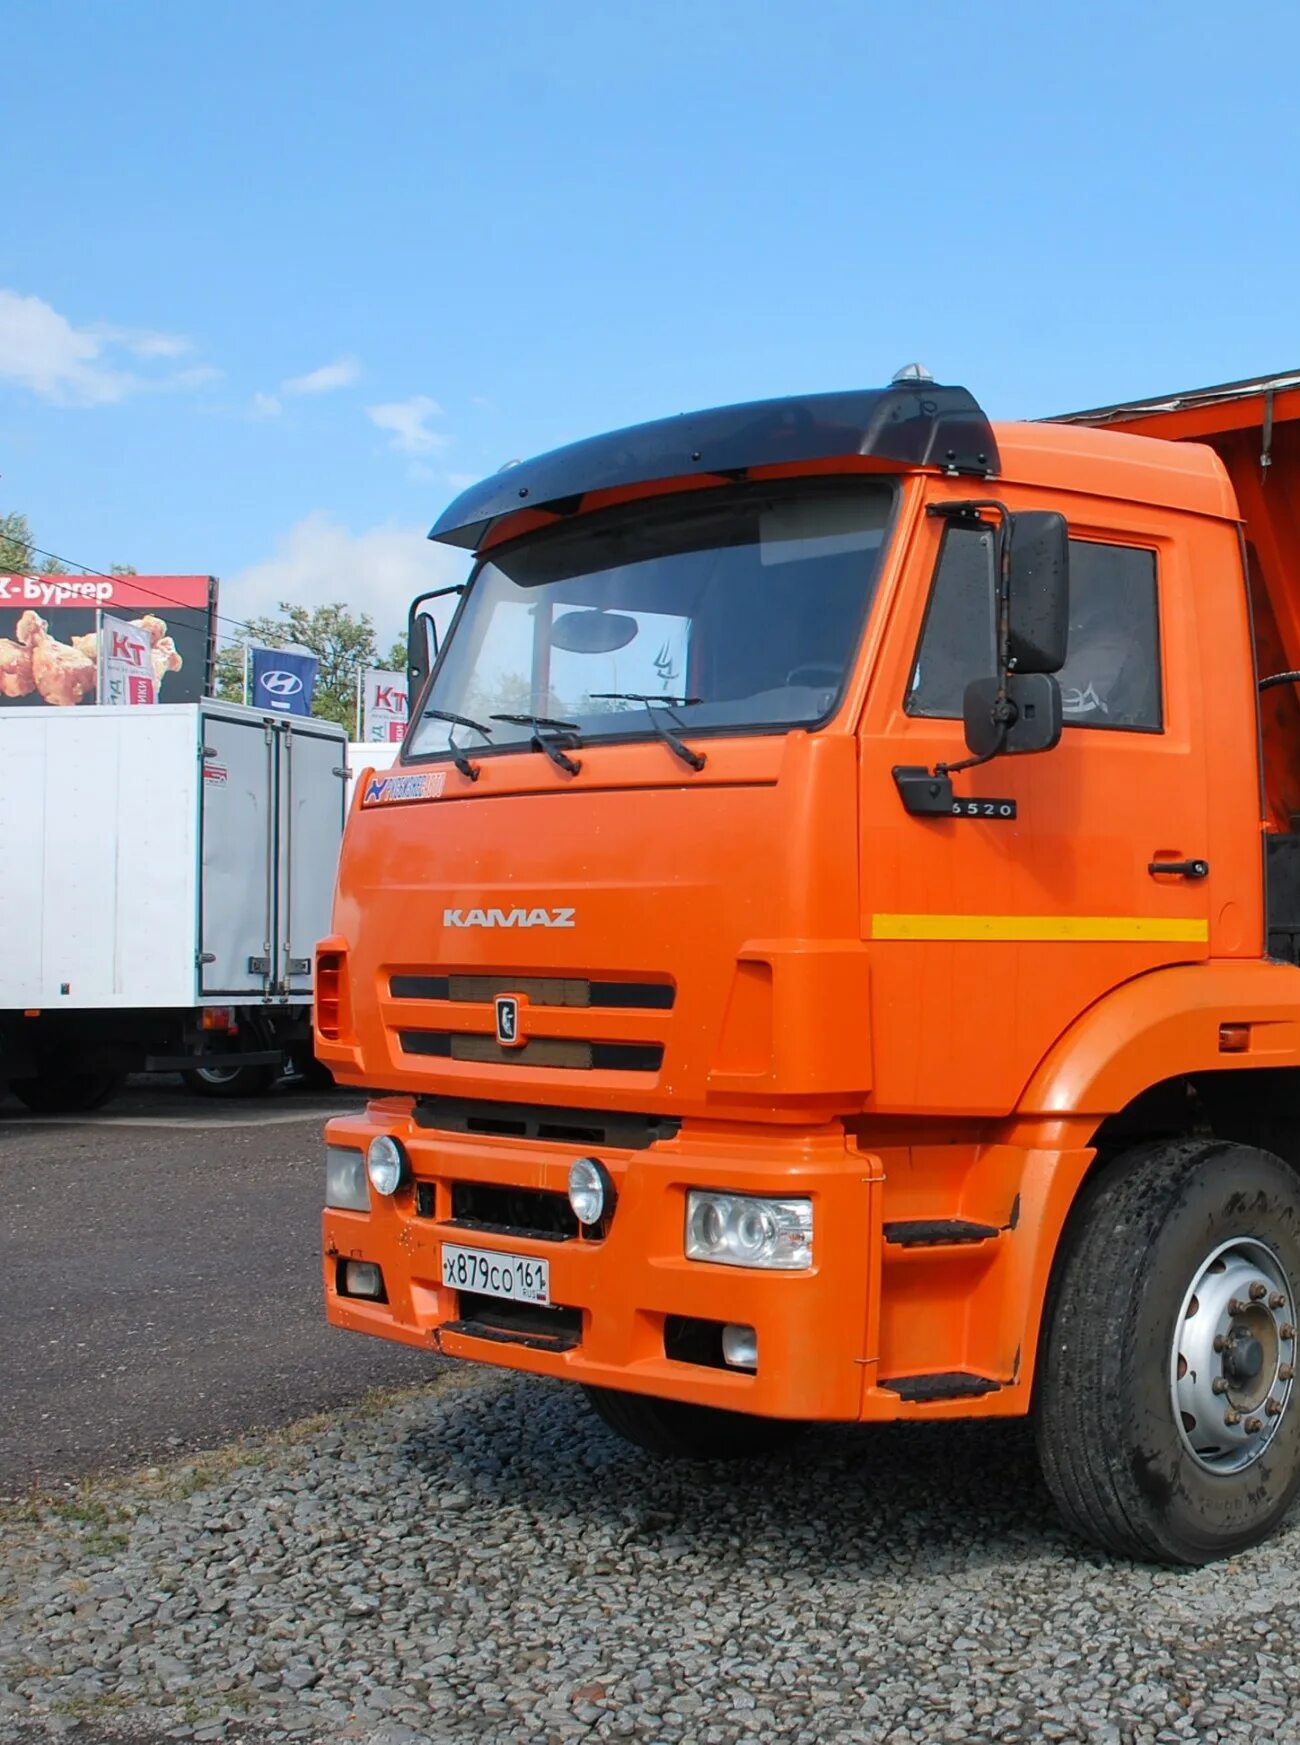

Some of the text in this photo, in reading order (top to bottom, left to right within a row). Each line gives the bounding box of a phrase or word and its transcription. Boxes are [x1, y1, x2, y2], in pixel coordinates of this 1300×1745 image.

[952, 802, 1012, 816] 6520
[443, 907, 576, 928] KAMAZ
[516, 1262, 543, 1290] 161
